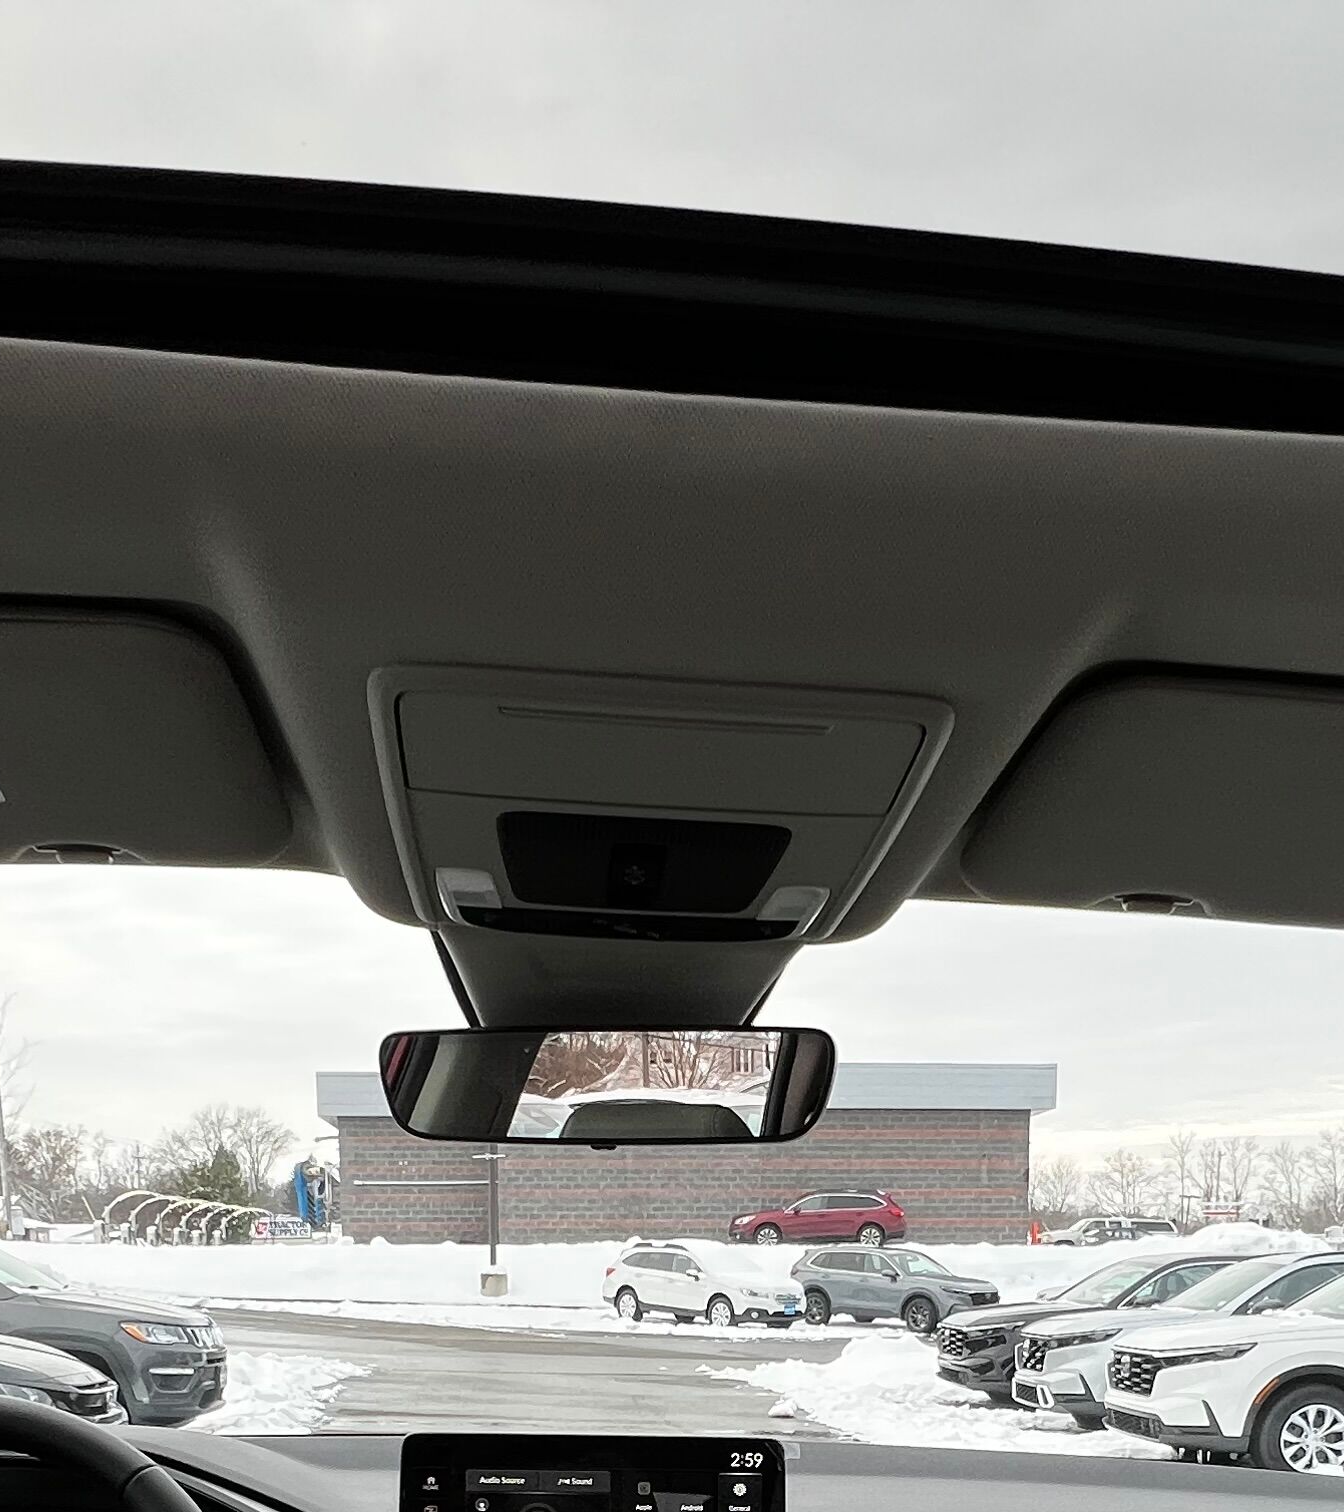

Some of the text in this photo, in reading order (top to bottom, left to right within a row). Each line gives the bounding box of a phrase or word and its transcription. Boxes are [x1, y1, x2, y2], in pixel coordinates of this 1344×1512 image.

[270, 1221, 307, 1229] TRACTOR
[269, 1228, 298, 1236] SUPPLY
[730, 1452, 763, 1468] 2:59
[478, 1476, 526, 1485] Audio Source
[571, 1477, 594, 1486] Sound
[680, 1504, 704, 1512] Android
